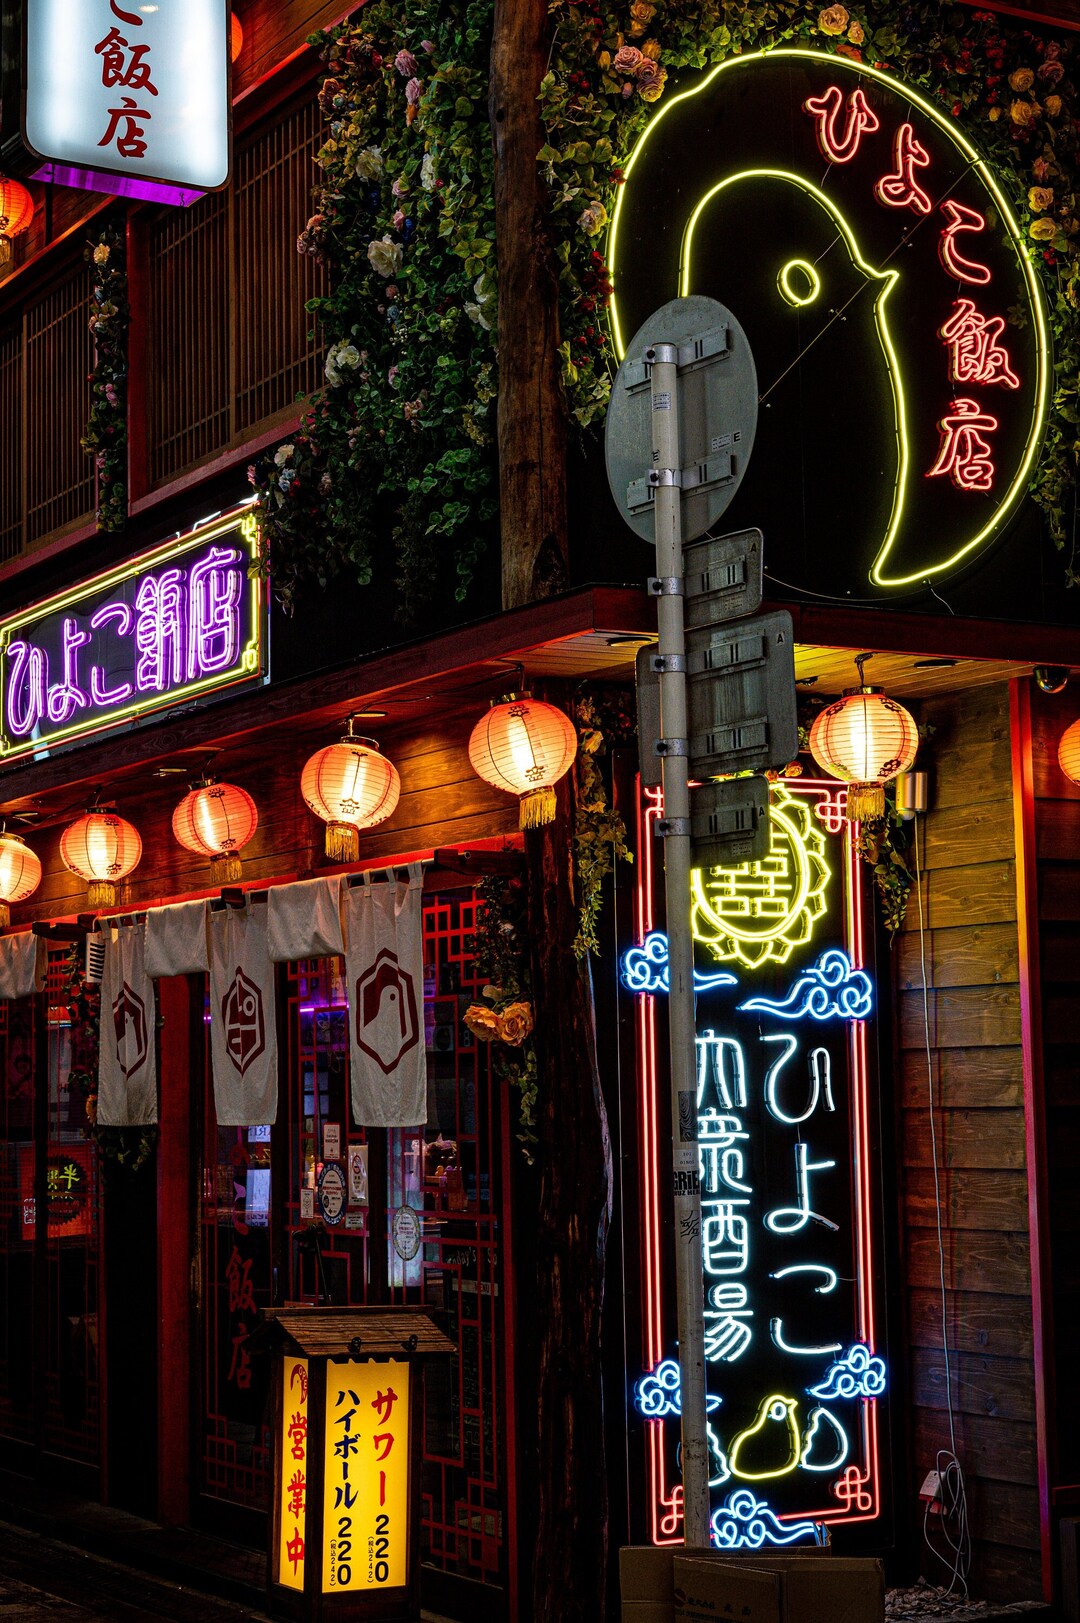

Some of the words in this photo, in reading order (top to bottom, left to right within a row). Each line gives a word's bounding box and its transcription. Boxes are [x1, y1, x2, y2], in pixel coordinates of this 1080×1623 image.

[802, 86, 1020, 491] ひよこ飯店
[750, 542, 757, 553] A
[7, 547, 242, 735] ひよこ飯店
[777, 633, 784, 644] A
[758, 806, 765, 817] A
[759, 1033, 843, 1355] ひよこ
[286, 1411, 308, 1577] 営業中
[334, 1389, 361, 1510] ハイボール
[371, 1387, 398, 1507] サワー
[337, 1517, 352, 1585] 220
[375, 1514, 389, 1582] 220
